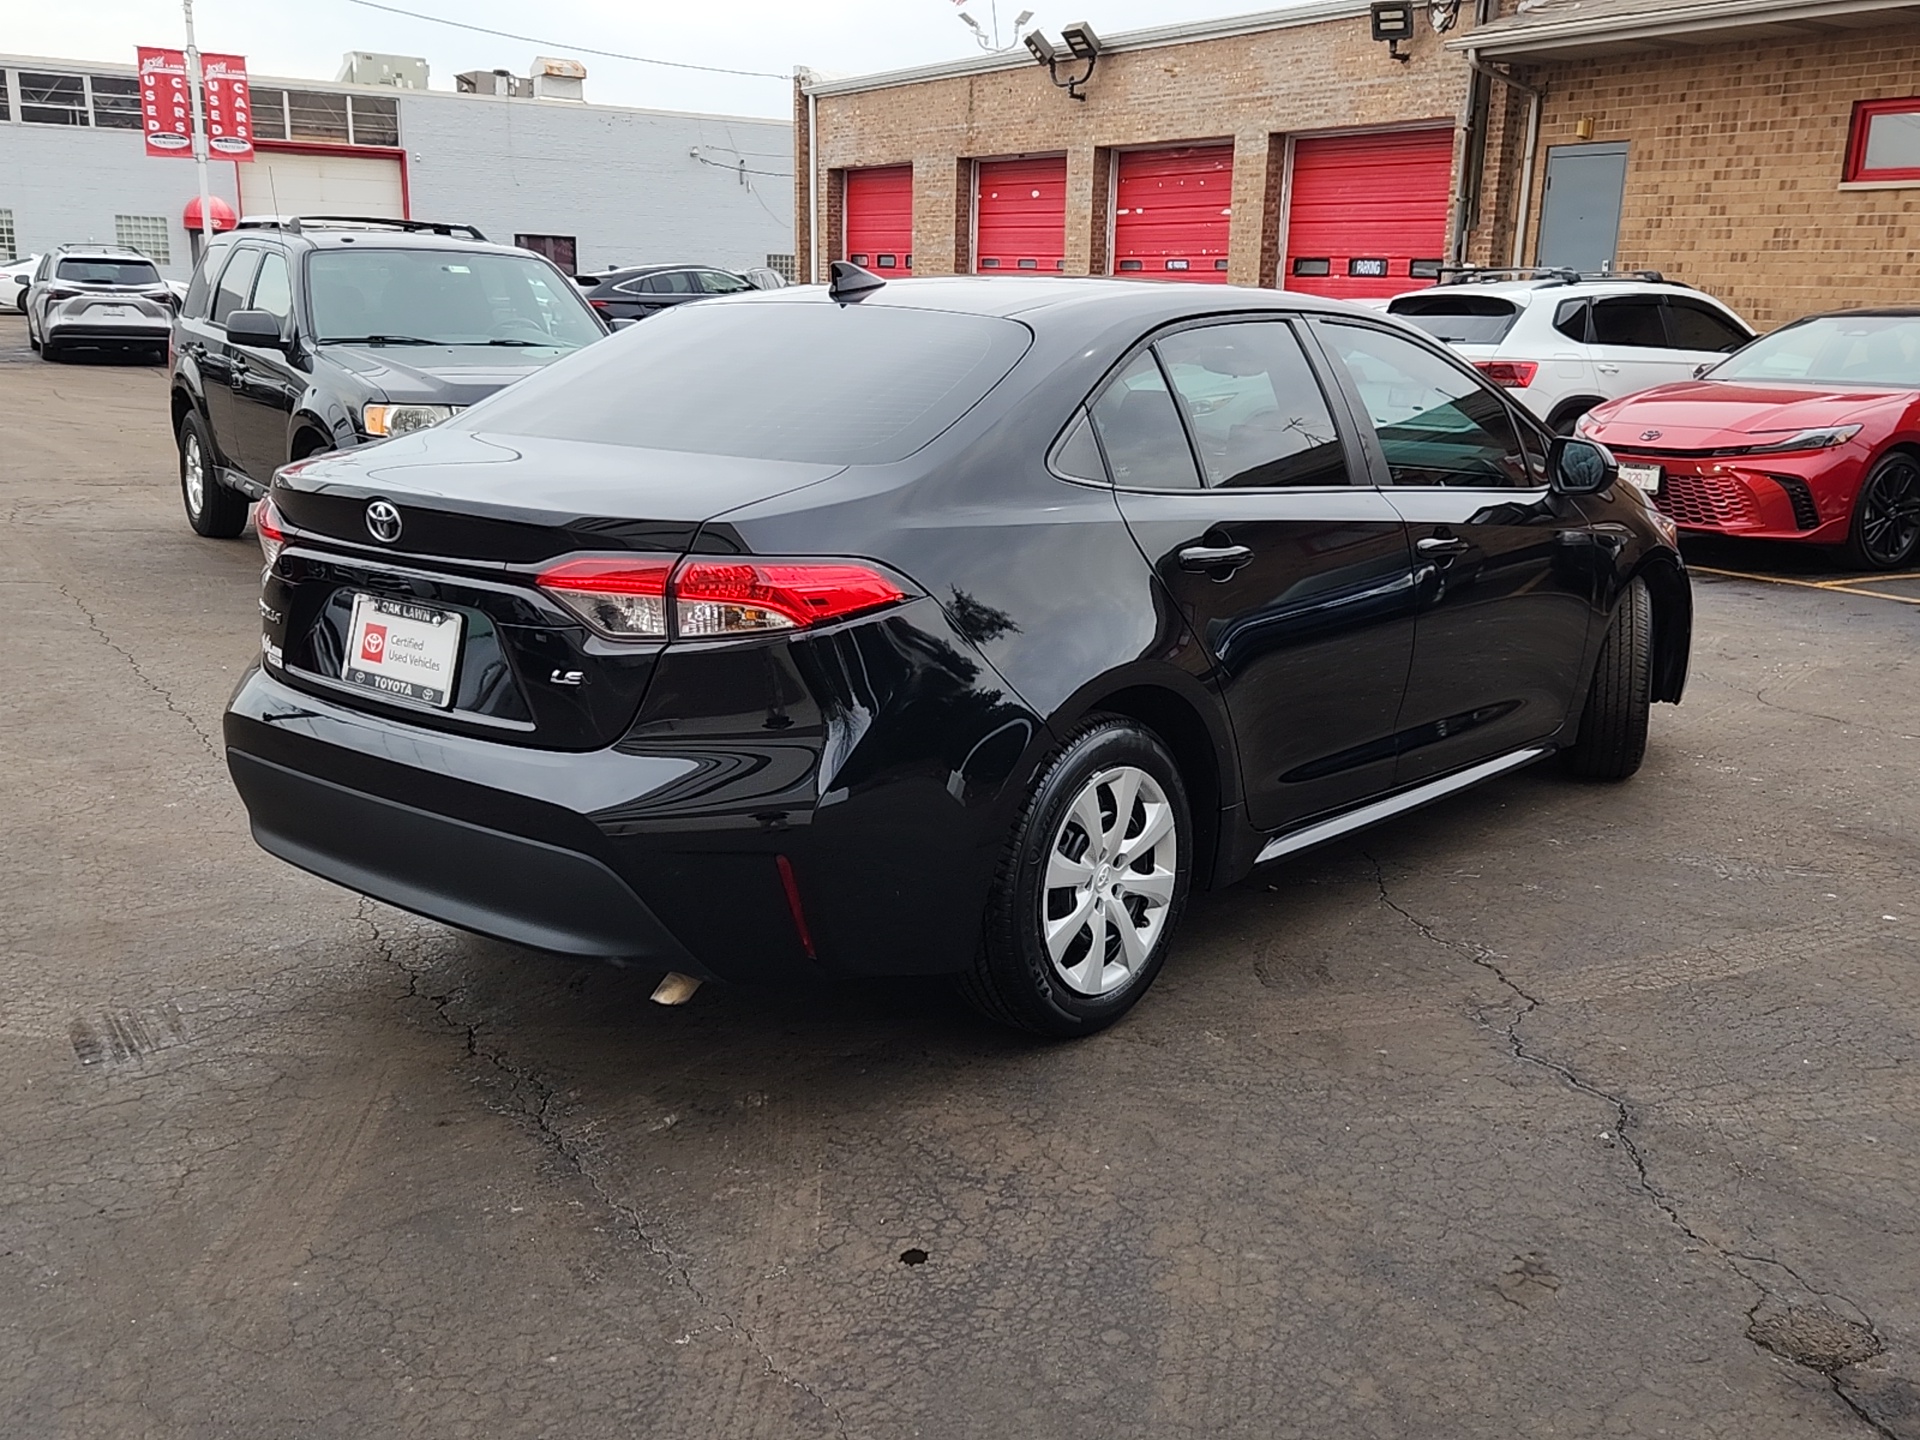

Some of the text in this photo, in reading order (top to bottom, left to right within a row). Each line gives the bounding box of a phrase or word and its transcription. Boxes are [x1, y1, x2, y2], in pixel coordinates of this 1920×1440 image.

[144, 75, 160, 131] USED
[171, 78, 185, 133] CARS
[208, 81, 223, 135] USED
[233, 83, 247, 137] CARS
[1356, 260, 1380, 275] PARKING
[382, 601, 431, 622] OAK LAWN
[391, 634, 424, 651] Certified
[388, 649, 440, 671] Used Vehicles
[374, 675, 413, 695] TOYOTA
[550, 669, 583, 685] LE
